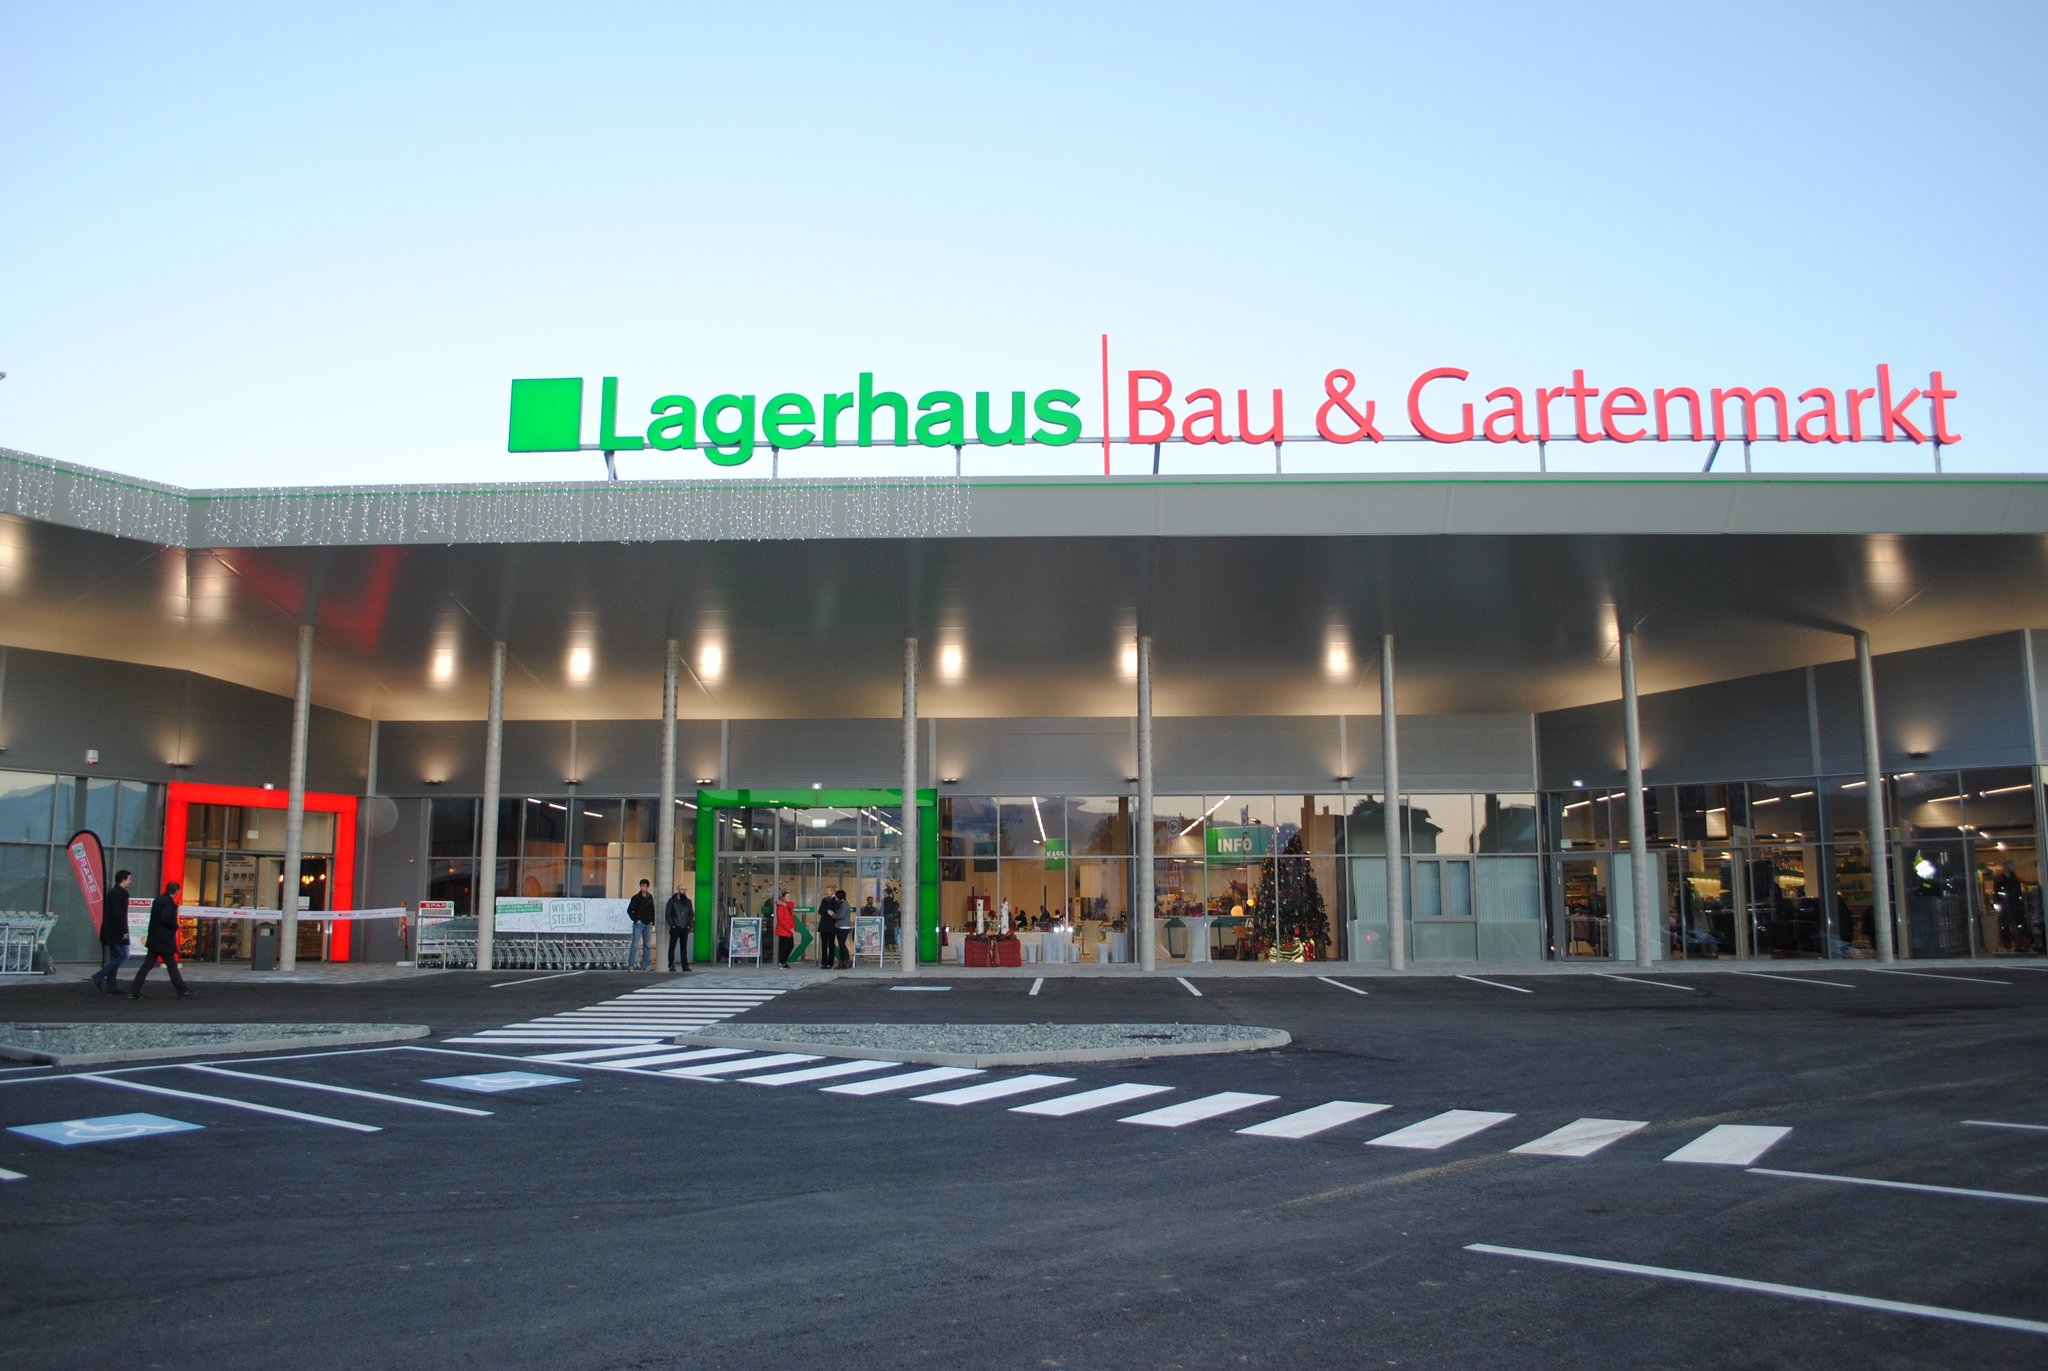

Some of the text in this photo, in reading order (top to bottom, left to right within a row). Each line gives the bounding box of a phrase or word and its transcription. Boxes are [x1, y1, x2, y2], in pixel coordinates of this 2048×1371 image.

[1125, 362, 1963, 445] Bau & Gartenmarkt
[599, 372, 1083, 466] Lagerhaus
[1217, 838, 1253, 853] INFO
[551, 903, 566, 913] WIR
[567, 902, 582, 912] SIND
[551, 913, 583, 925] STEIRER
